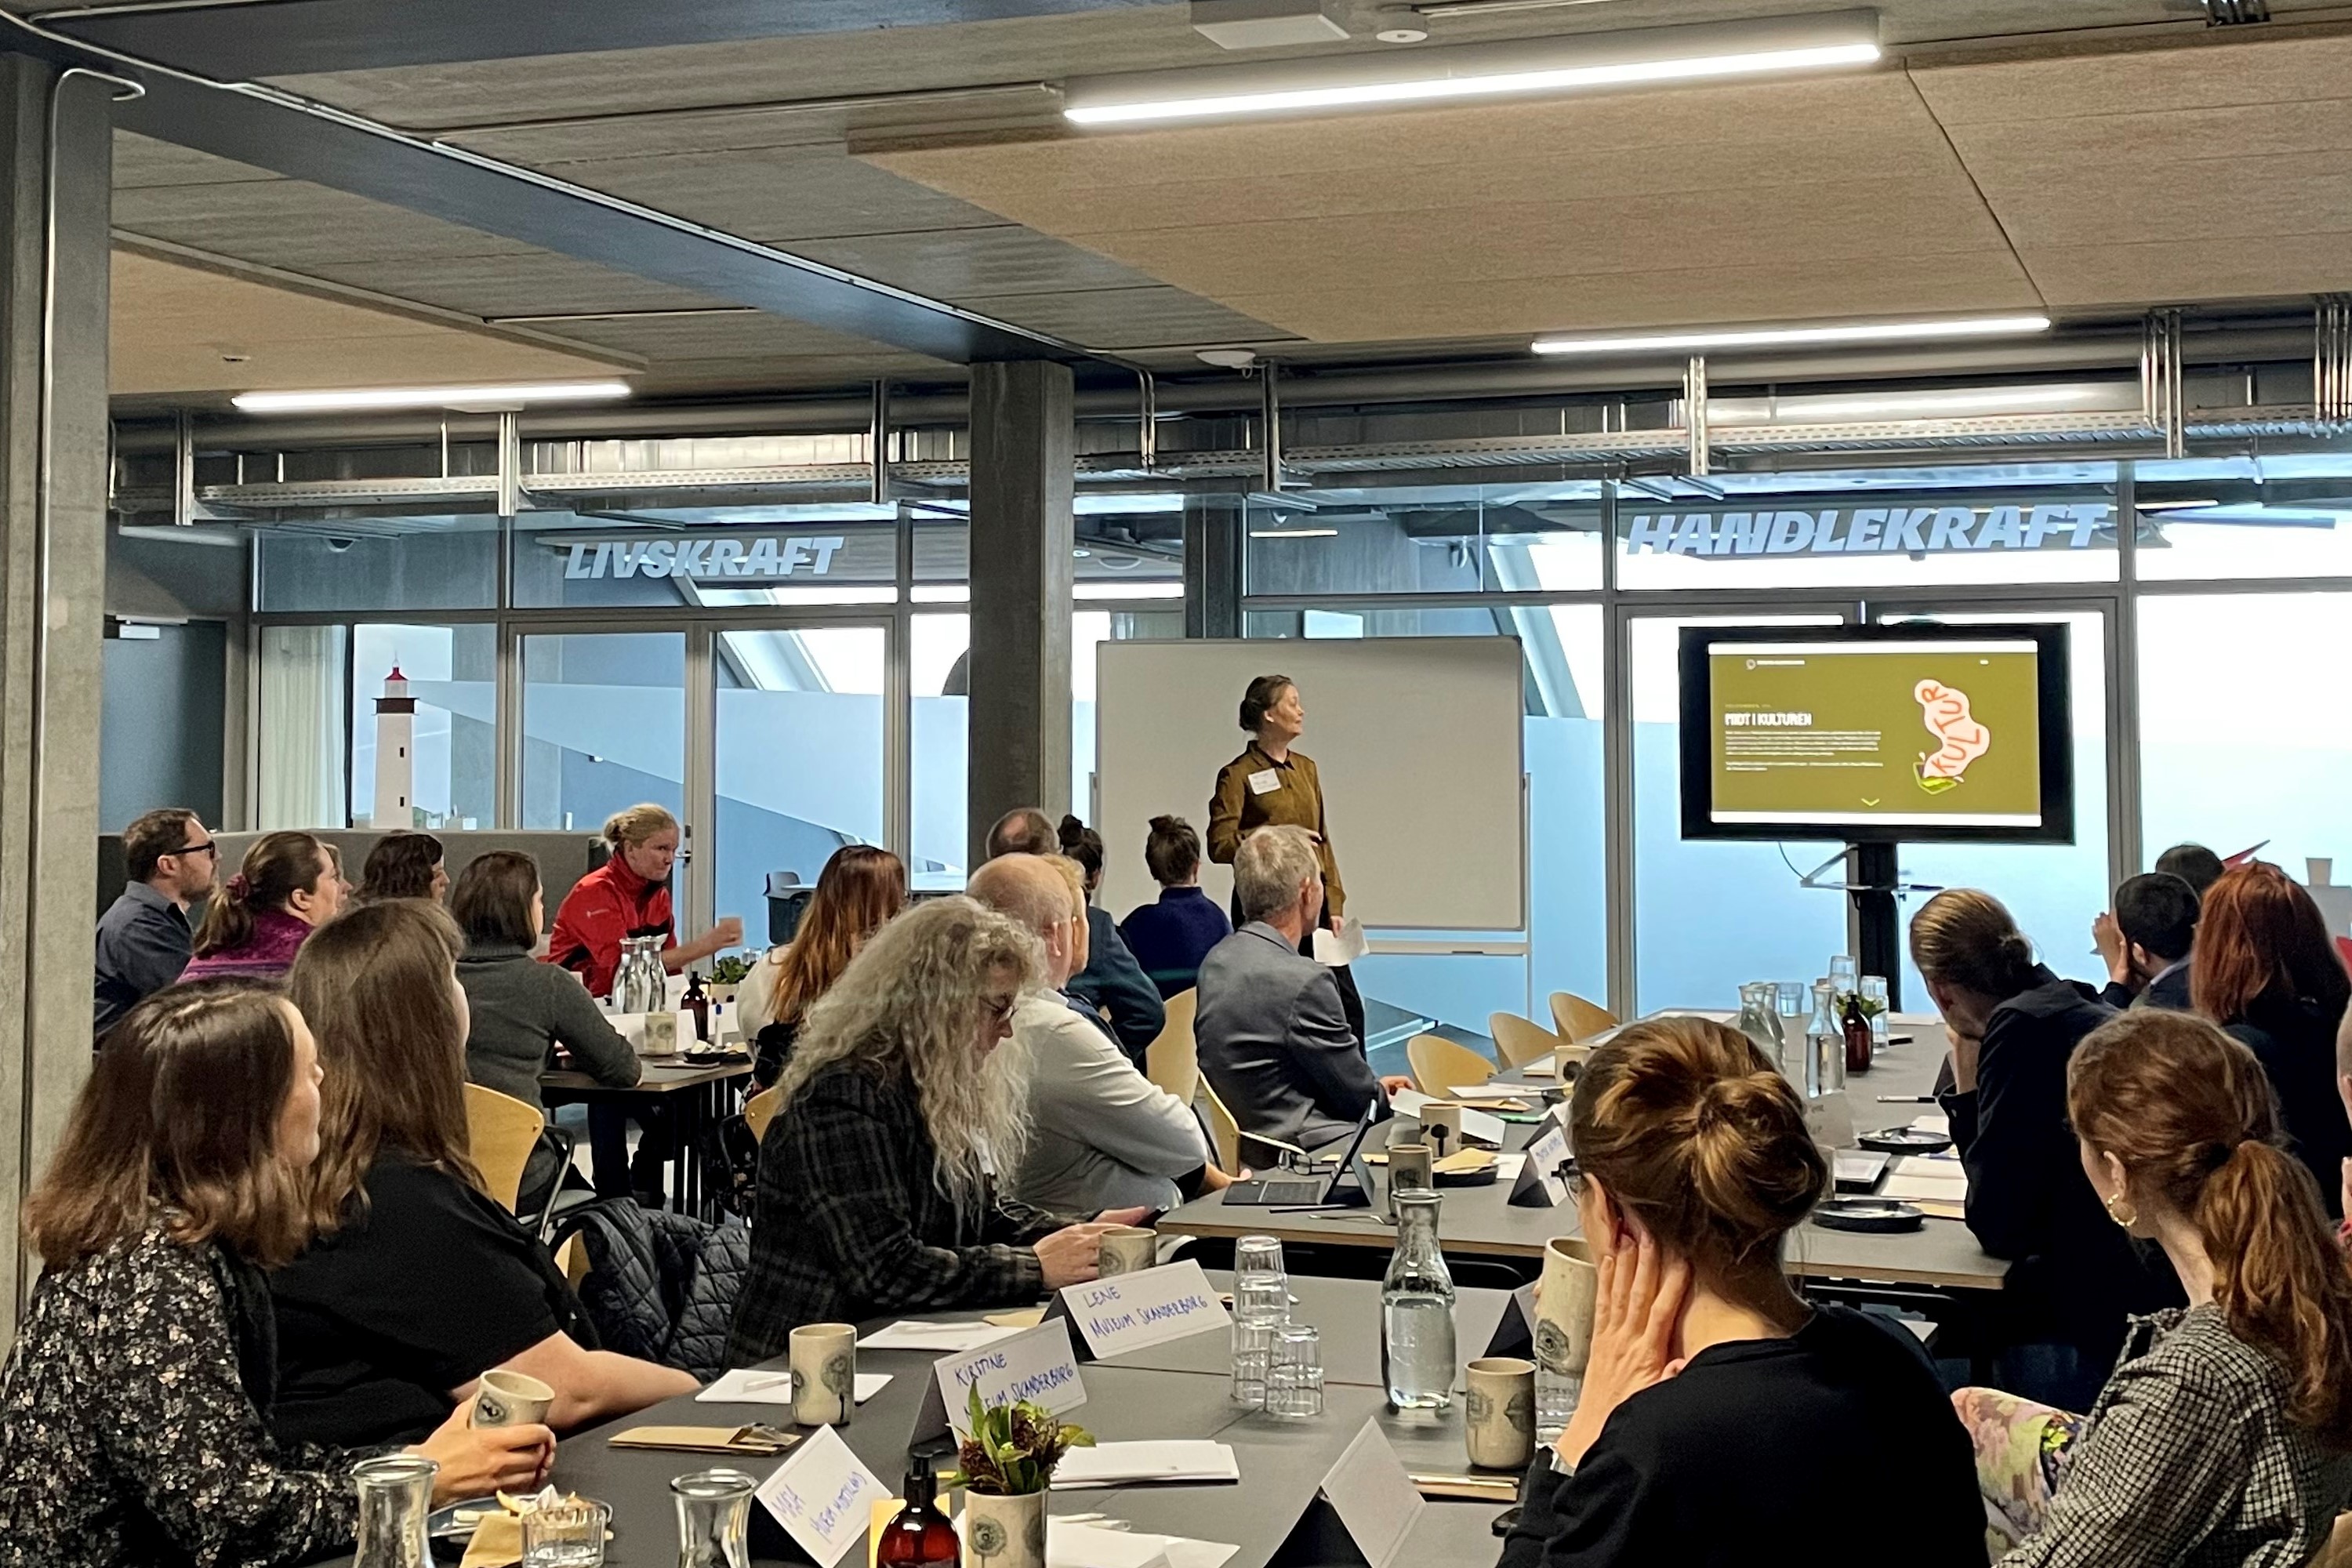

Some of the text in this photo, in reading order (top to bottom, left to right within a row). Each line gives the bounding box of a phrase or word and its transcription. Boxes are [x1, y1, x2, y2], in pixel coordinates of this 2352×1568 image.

[1627, 503, 2109, 555] HANDLEKRAFT
[564, 536, 844, 579] LIVSKRAFT
[1758, 713, 1813, 726] KULTUREN
[1922, 685, 1980, 774] KULTUR
[1083, 1286, 1121, 1308] LENE
[1089, 1295, 1208, 1339] MUSEUM SKANDERBORG
[1011, 1363, 1074, 1403] SKANDERBORG
